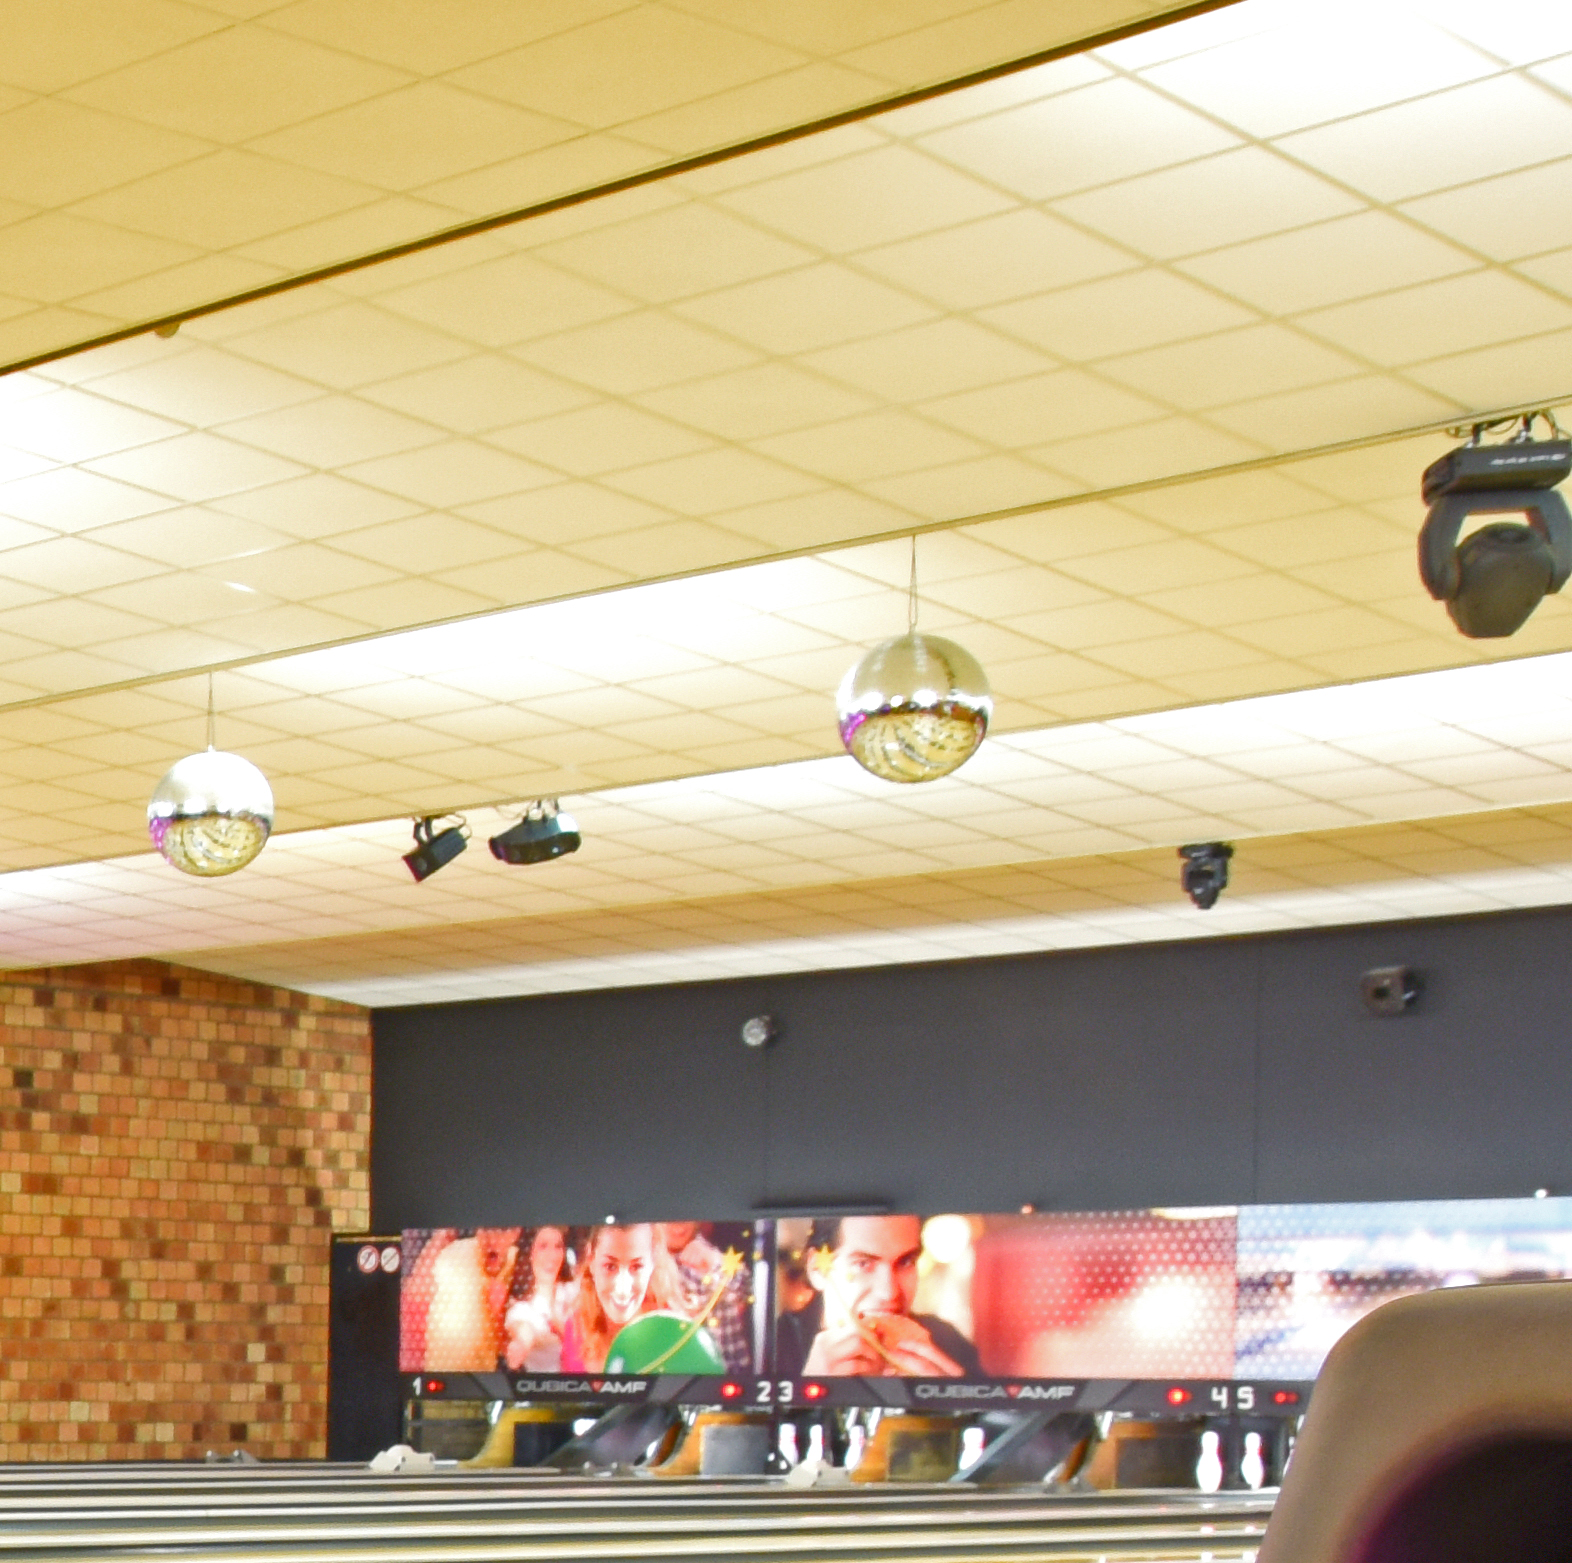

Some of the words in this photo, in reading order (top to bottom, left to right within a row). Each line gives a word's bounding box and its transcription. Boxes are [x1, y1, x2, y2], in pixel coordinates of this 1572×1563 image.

[412, 1377, 422, 1396] 1
[756, 1381, 771, 1402] 2
[778, 1381, 794, 1402] 3
[1211, 1386, 1228, 1409] 4
